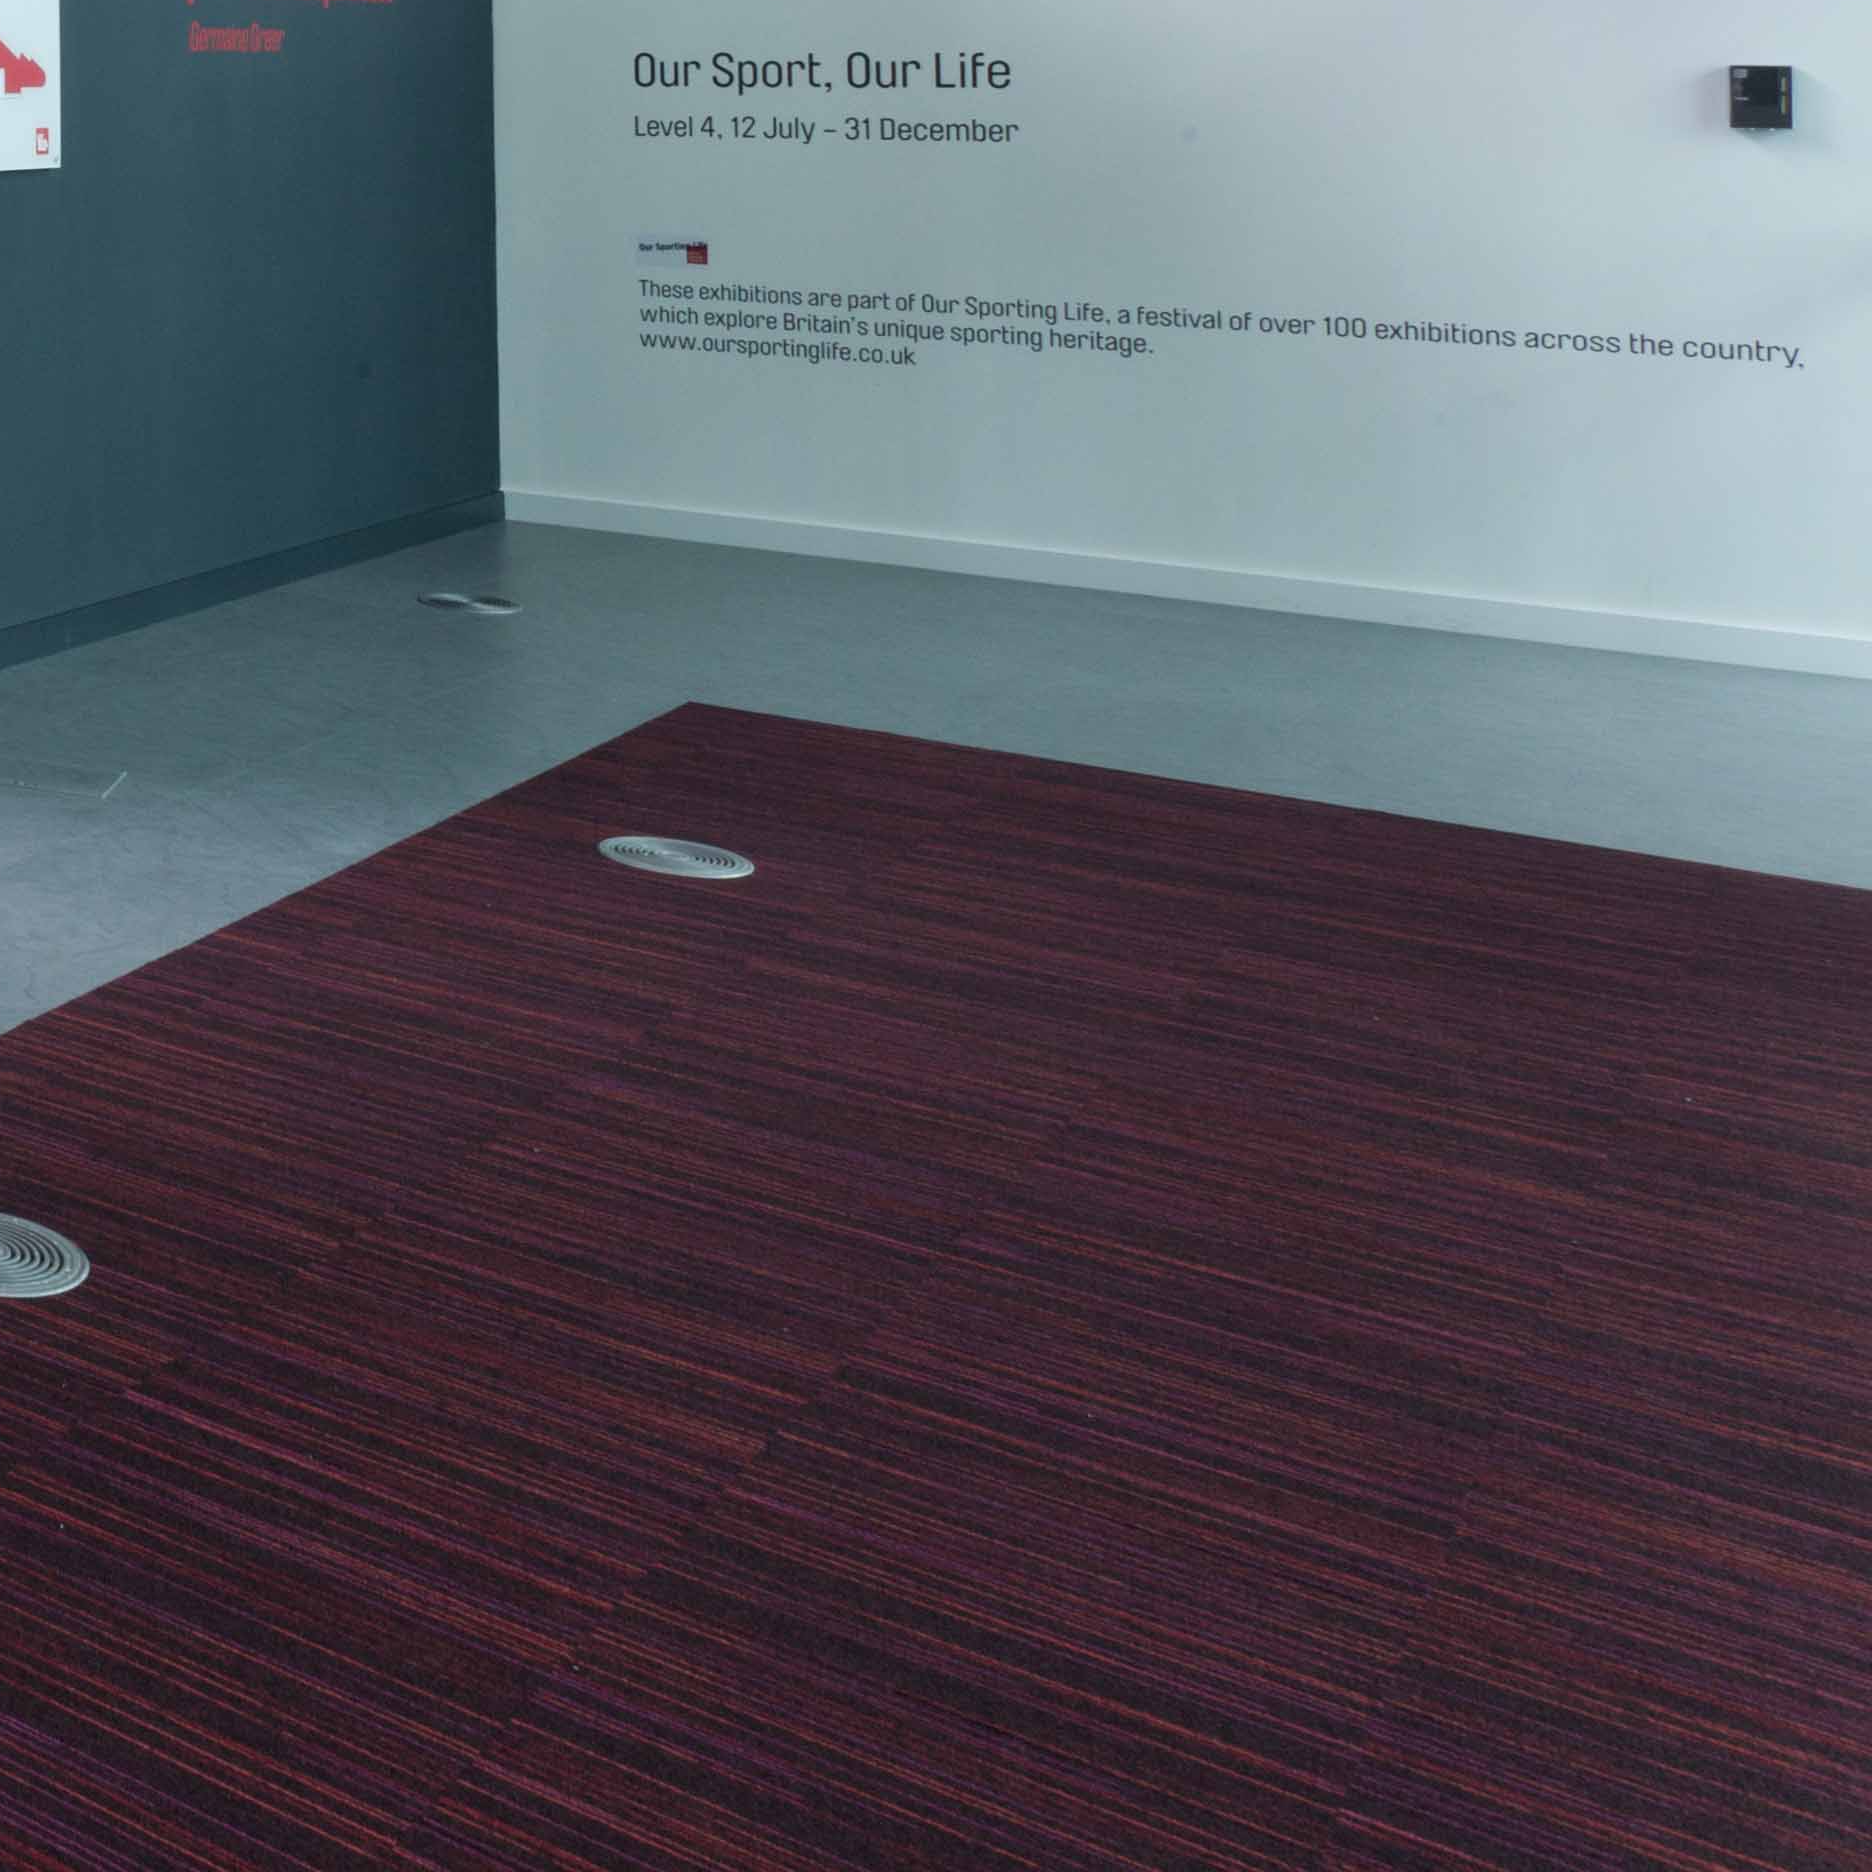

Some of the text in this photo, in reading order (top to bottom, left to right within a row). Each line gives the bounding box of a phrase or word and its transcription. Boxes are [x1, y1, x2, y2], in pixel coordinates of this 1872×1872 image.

[634, 51, 1011, 97] Our Sport, Our Life
[634, 115, 693, 138] Level
[700, 115, 723, 140] 4,
[731, 115, 756, 139] 12
[762, 116, 816, 145] July
[844, 116, 871, 141] 31
[879, 117, 1020, 143] December
[638, 279, 694, 300] These
[698, 283, 803, 306] exhibitions
[807, 291, 843, 308] are
[847, 292, 891, 313] part
[895, 293, 916, 312] of
[921, 293, 960, 314] Our
[964, 295, 1057, 326] Sporting
[1117, 308, 1131, 325] a
[1136, 305, 1222, 330] festival
[1229, 311, 1253, 331] of
[1259, 316, 1316, 335] over
[1323, 316, 1367, 339] 100
[1374, 320, 1517, 348] exhibitions
[1523, 331, 1621, 354] across
[1629, 332, 1674, 357] the
[639, 305, 1153, 359] which explore Britain's unique sporting heritage.
[639, 331, 918, 366] www.oursportinglife.co.uk
